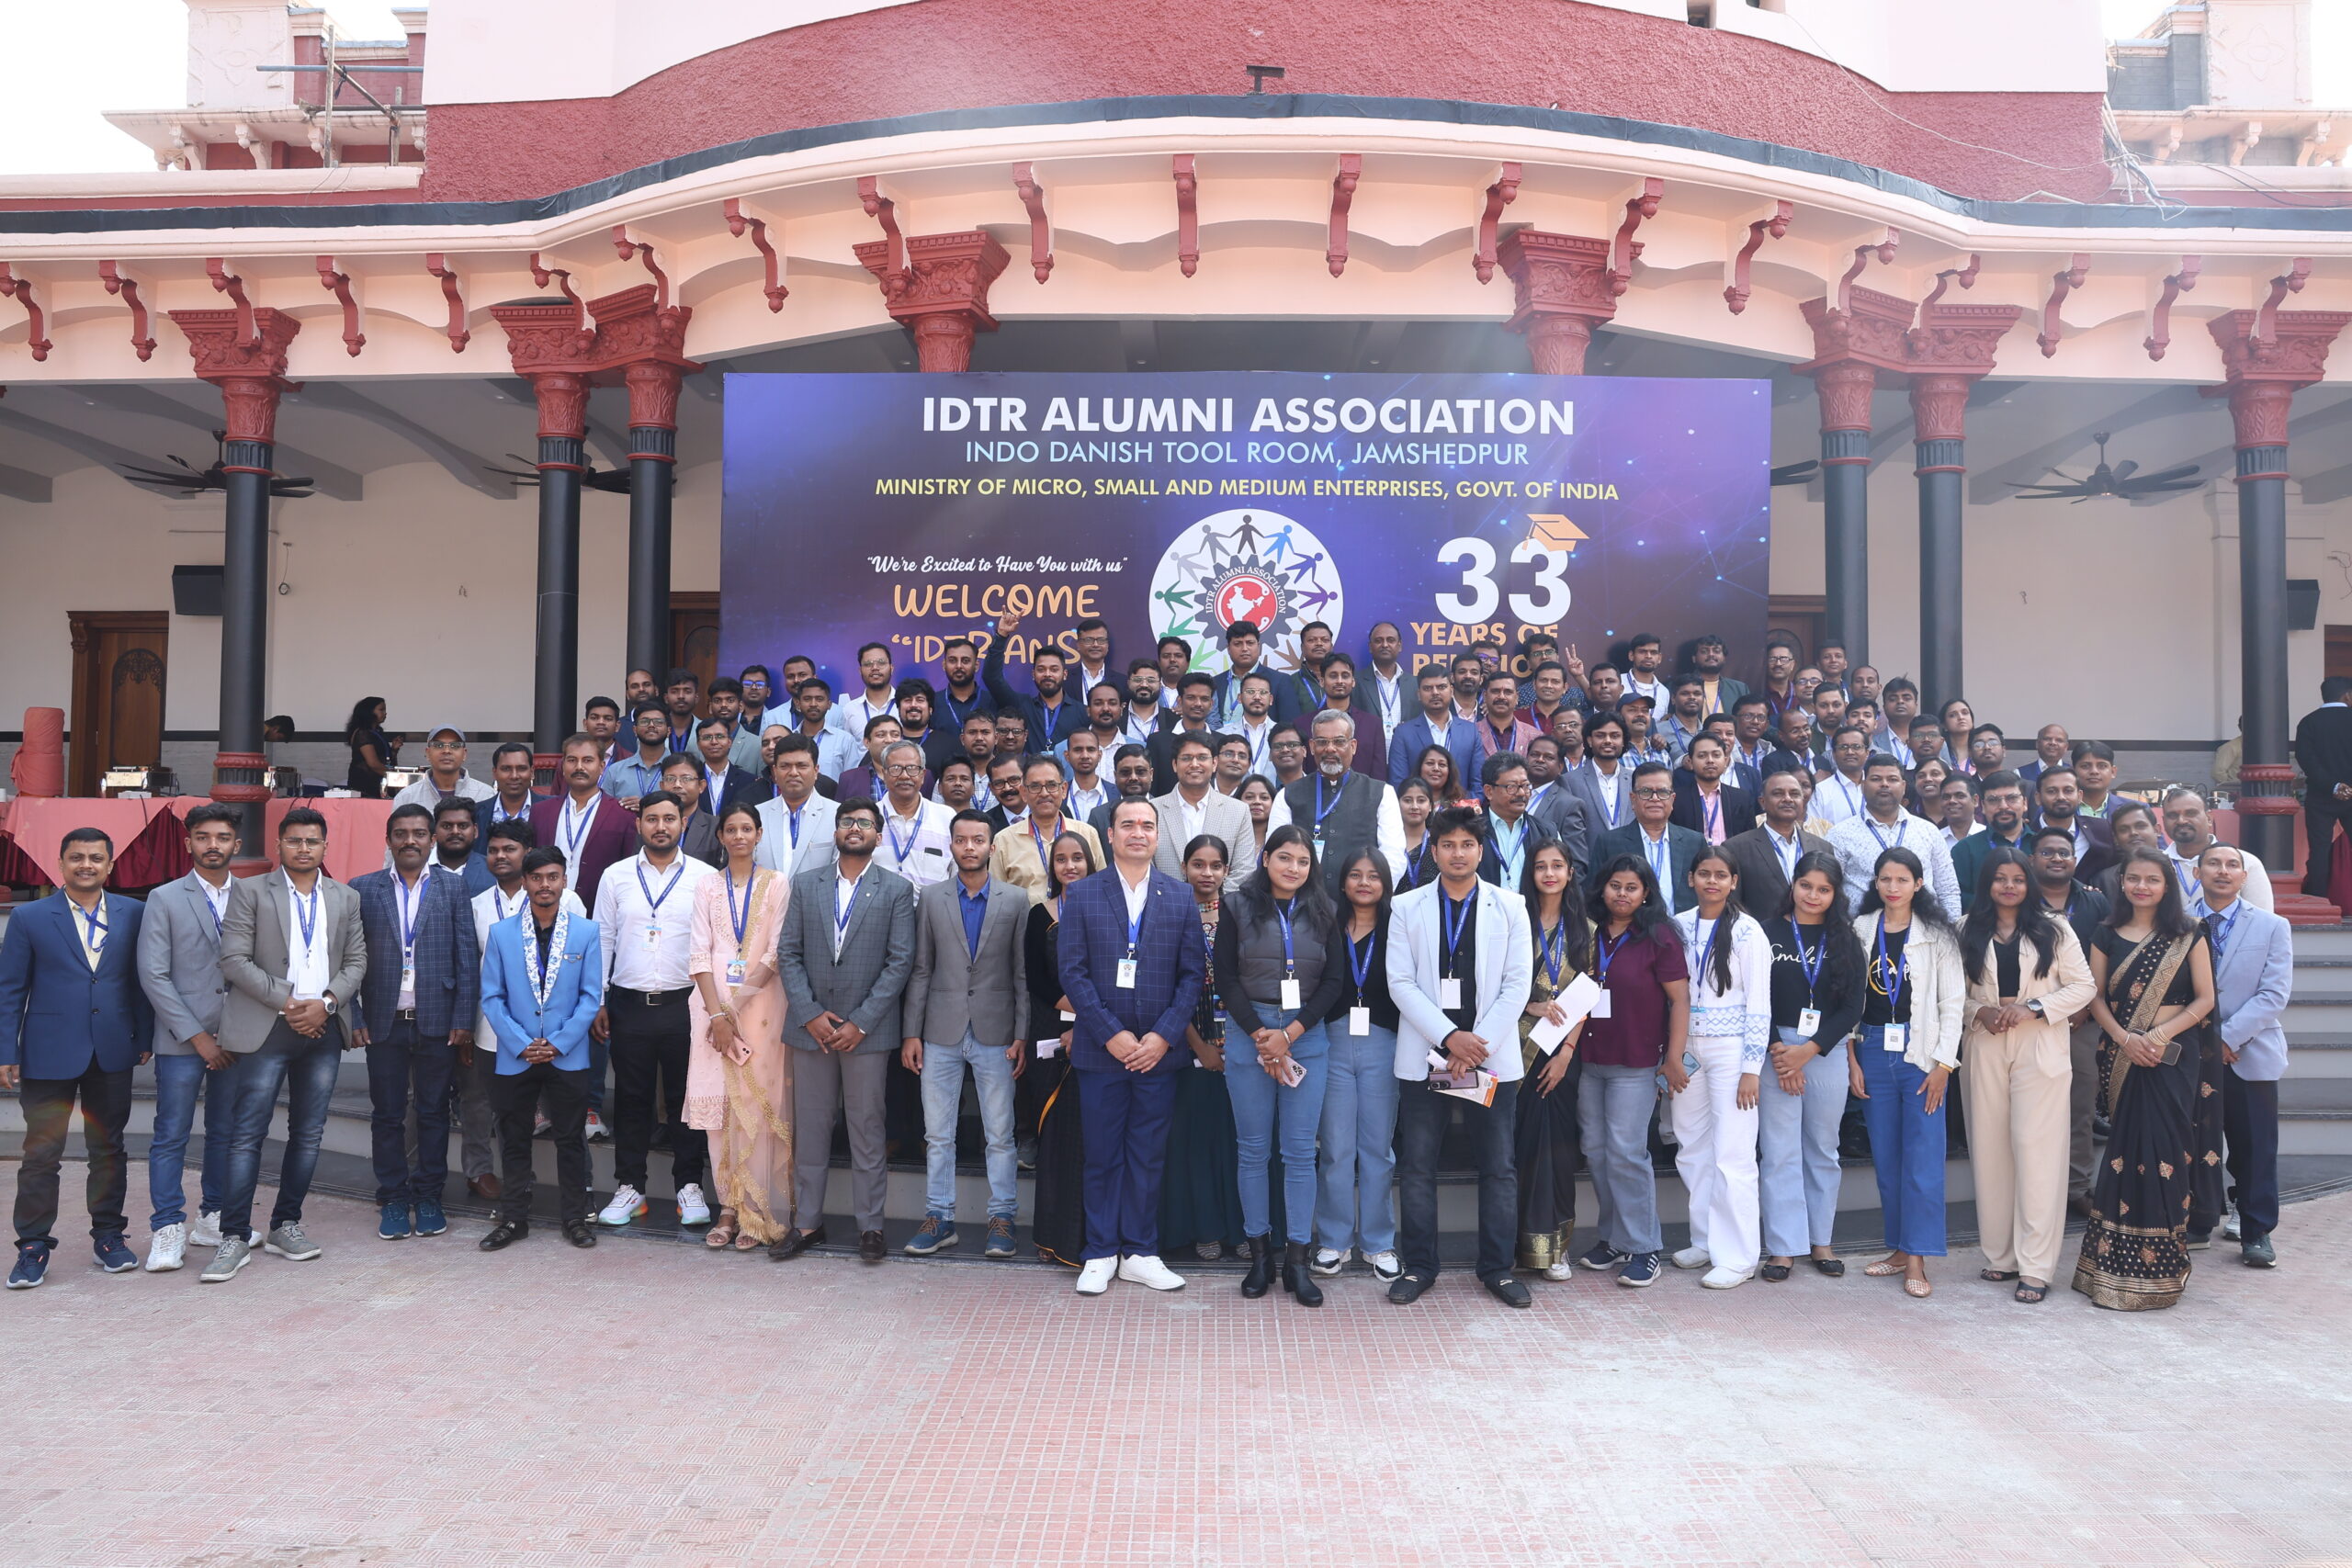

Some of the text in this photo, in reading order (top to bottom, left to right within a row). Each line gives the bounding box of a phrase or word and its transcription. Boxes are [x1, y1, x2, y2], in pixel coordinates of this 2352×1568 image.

[923, 397, 1574, 435] IDTR ALUMNI ASSOCIATION
[967, 441, 1529, 468] INDO DANISH TOOL ROOM, JAMSHEDPUR
[876, 479, 1620, 501] MINISTRY OF MICRO, SMALL AND MEDIUM ENTERPRISES, GOVT. OF INDIA
[921, 556, 976, 573] Excited
[978, 558, 992, 572] to
[995, 556, 1035, 573] Have
[1035, 556, 1069, 573] You
[1070, 558, 1103, 573] with
[1204, 566, 1287, 614] IDTR ALUMNI ASSOCIATION
[1435, 536, 1571, 625] 33
[894, 583, 1101, 618] WELCOME
[1409, 622, 1507, 647] YEARS
[1770, 943, 1816, 964] Smile
